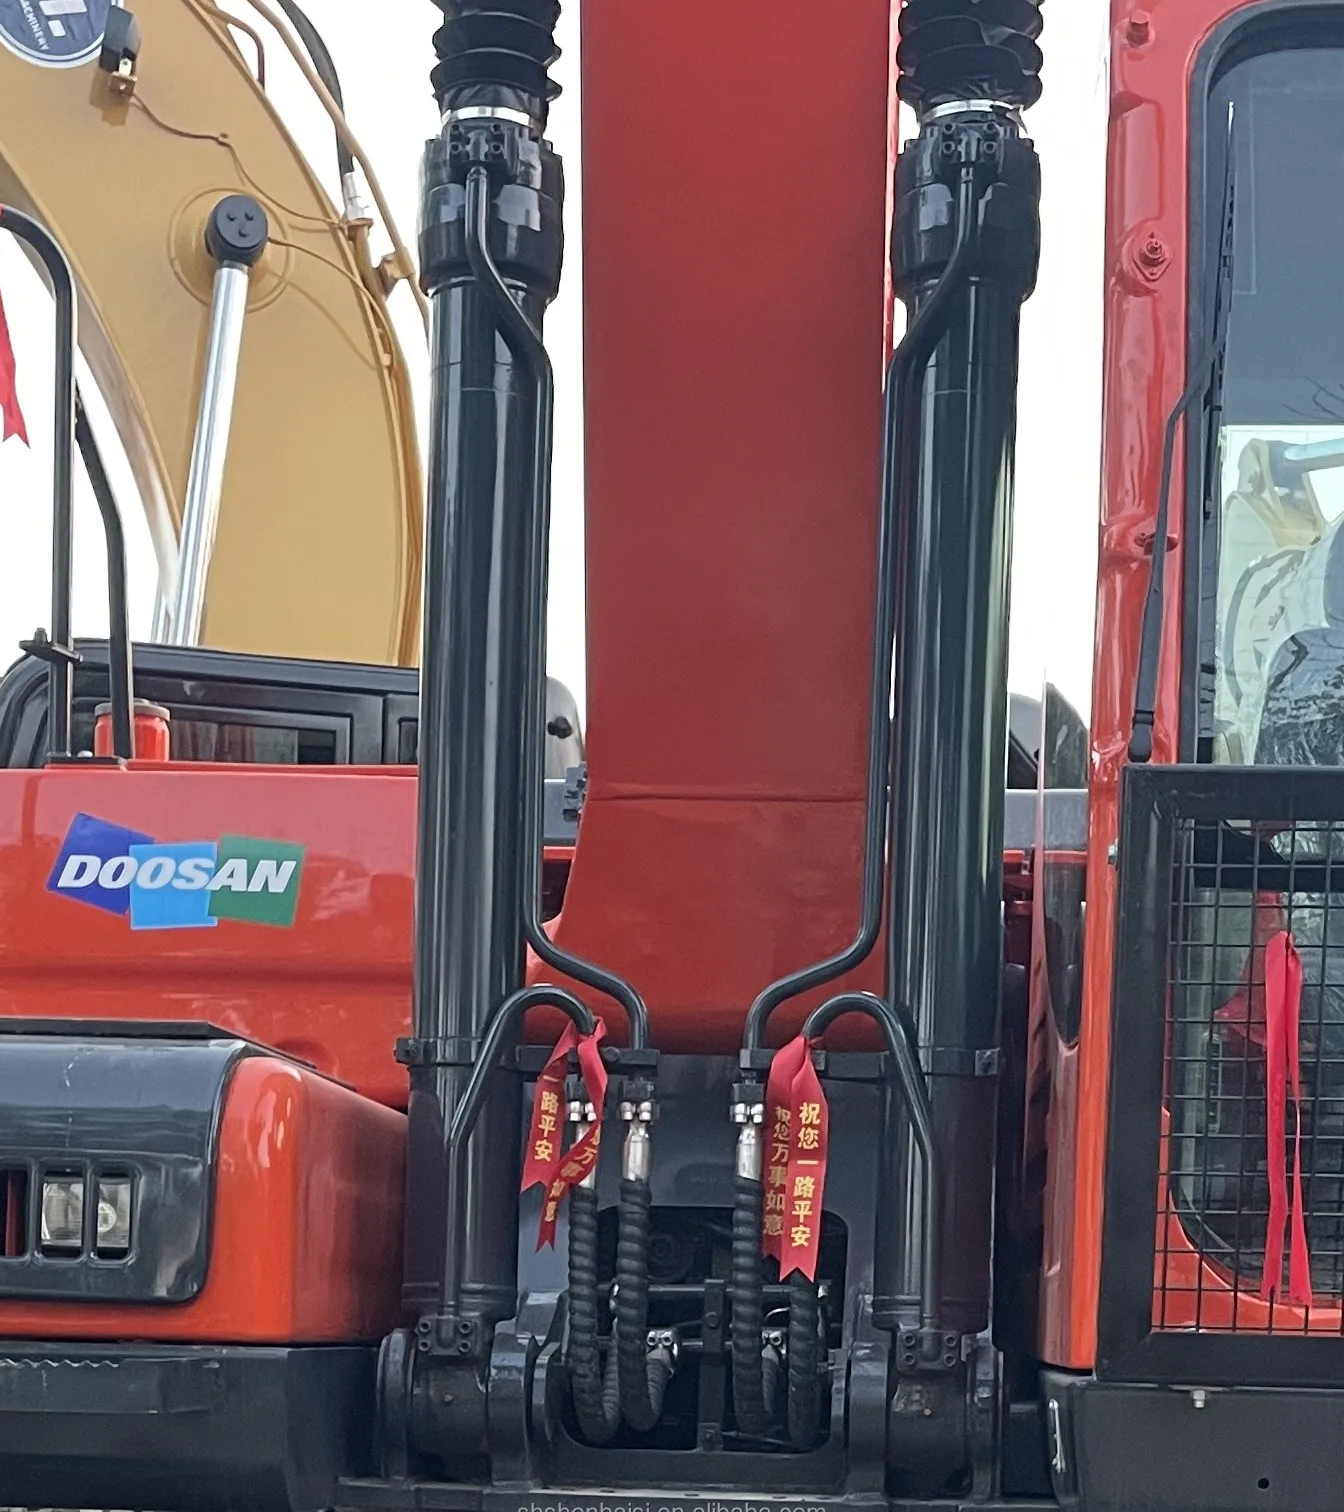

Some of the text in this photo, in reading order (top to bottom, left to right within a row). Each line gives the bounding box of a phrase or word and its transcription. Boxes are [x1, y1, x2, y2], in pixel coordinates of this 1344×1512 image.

[57, 854, 297, 893] DOOSAN
[790, 1101, 822, 1248] 祝您一路平安
